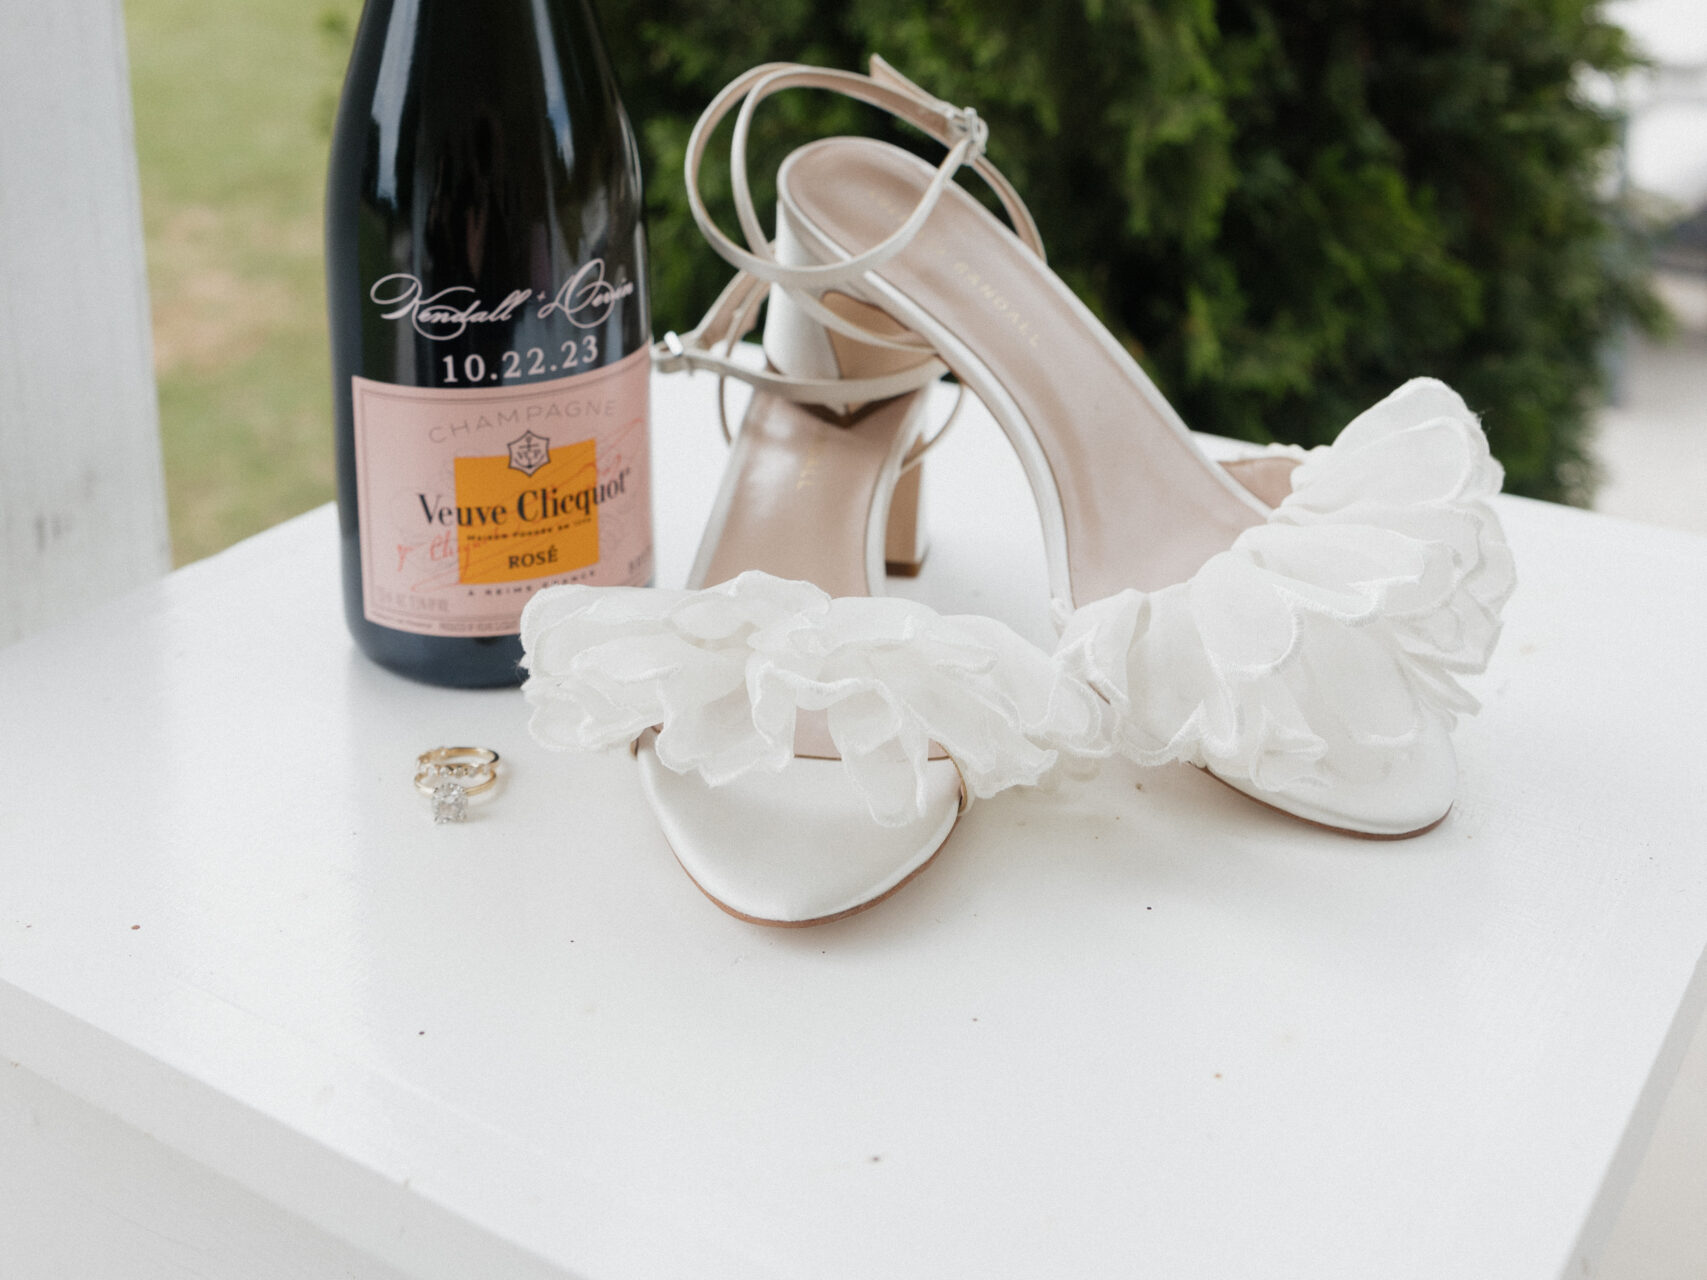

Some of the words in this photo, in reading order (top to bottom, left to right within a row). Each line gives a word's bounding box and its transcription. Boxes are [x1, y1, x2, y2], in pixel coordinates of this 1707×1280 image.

[370, 273, 532, 341] Kendall
[442, 335, 598, 383] 10.22.23
[428, 400, 616, 443] CHAMPAGNE
[418, 493, 507, 527] Veuve
[517, 471, 626, 522] Clicquot
[508, 545, 558, 569] ROSÉ
